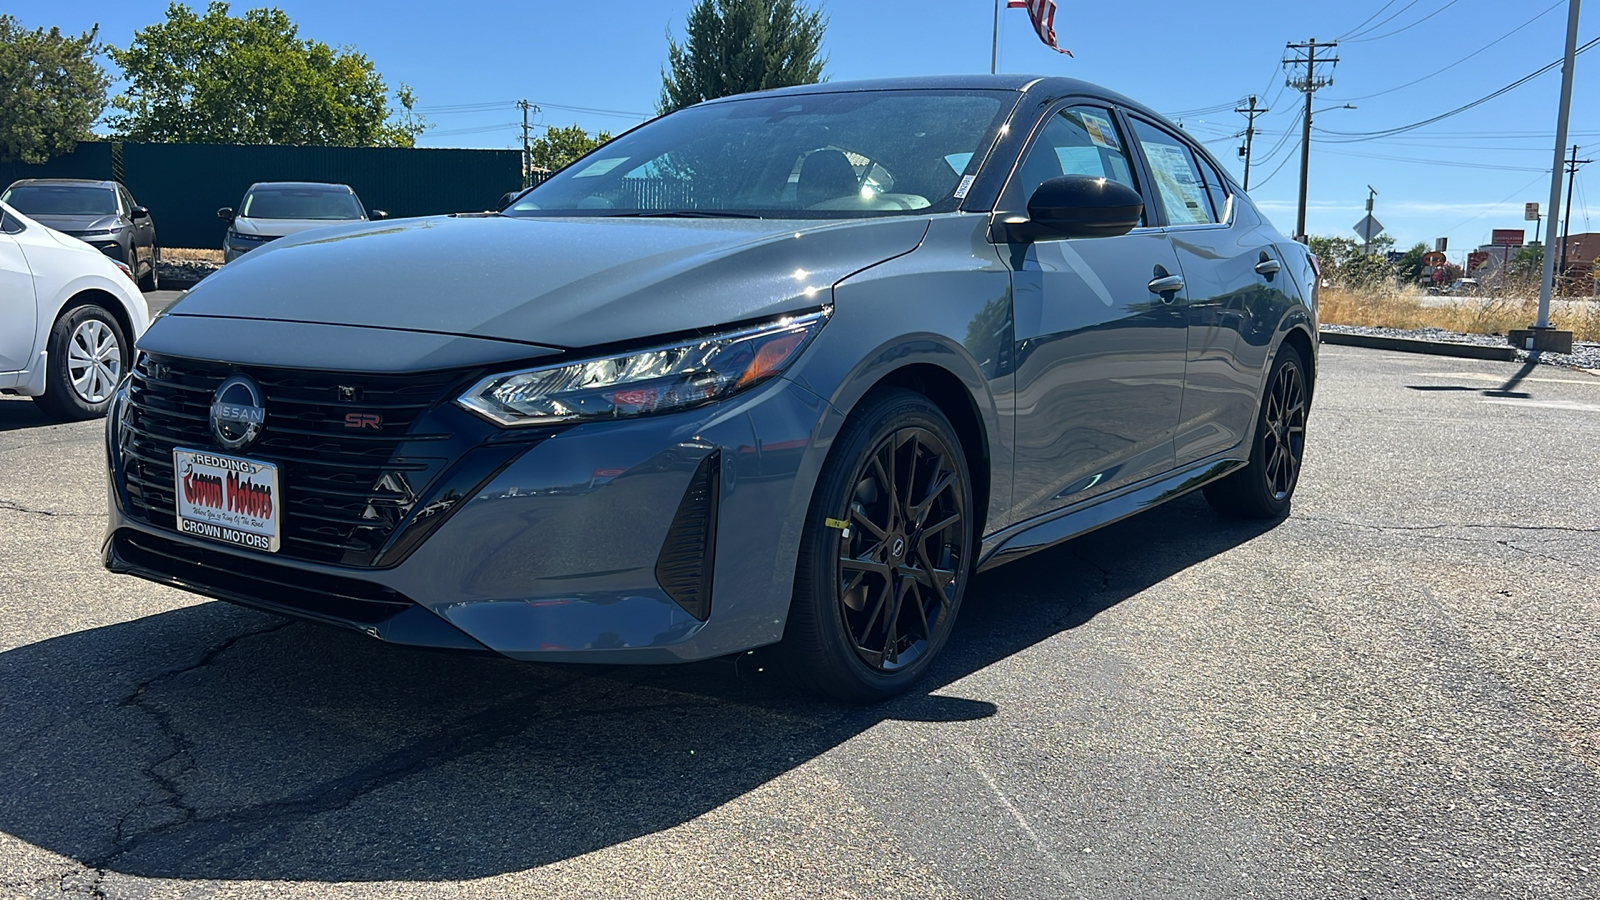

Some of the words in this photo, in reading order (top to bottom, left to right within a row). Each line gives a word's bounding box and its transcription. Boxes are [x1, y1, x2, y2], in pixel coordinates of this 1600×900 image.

[213, 404, 262, 421] NISSAN
[345, 412, 380, 430] SR
[196, 454, 249, 472] REDDING
[183, 464, 223, 509] Crown
[226, 470, 272, 520] Motors
[240, 516, 250, 525] The
[250, 519, 264, 528] Road
[183, 520, 220, 537] CROWN
[223, 528, 269, 548] MOTORS
